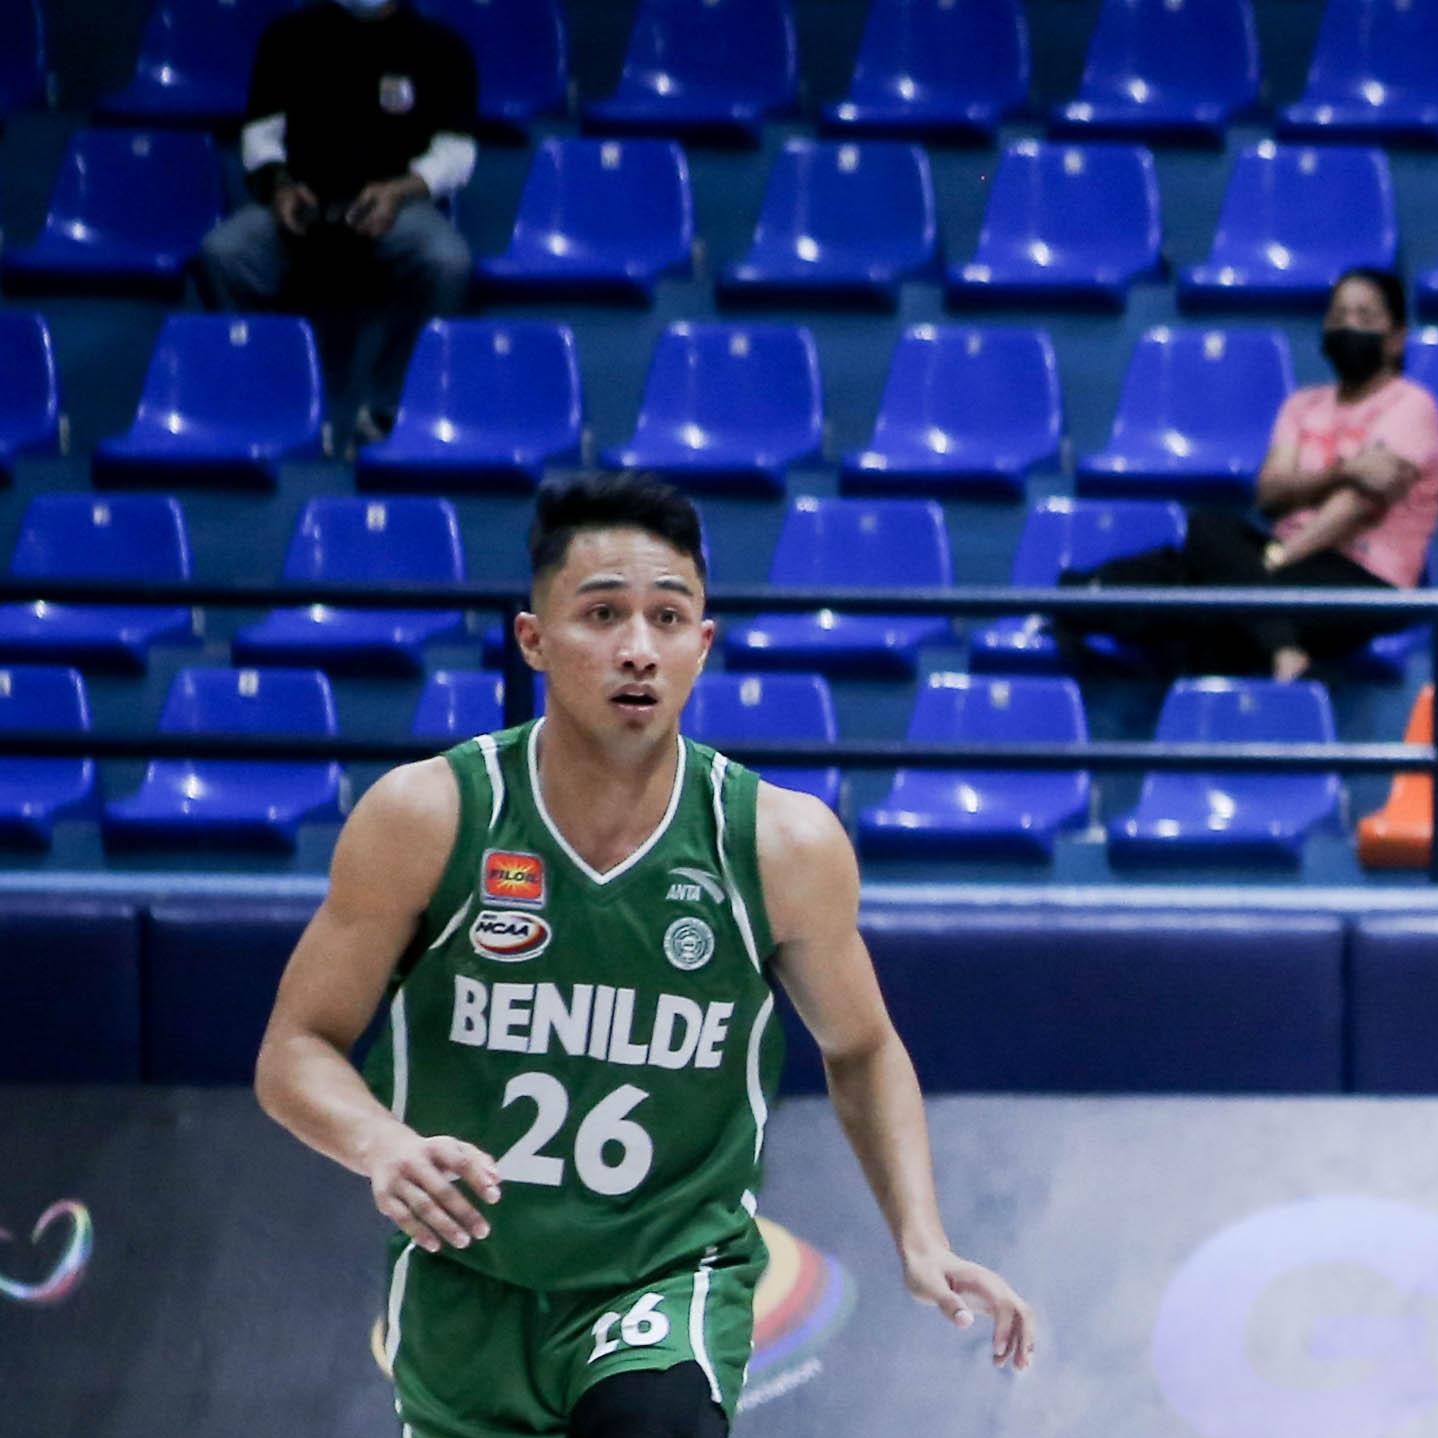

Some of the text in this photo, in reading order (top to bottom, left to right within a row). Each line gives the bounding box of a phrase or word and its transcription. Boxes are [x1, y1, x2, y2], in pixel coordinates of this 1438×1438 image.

[665, 884, 700, 901] ANTA
[476, 921, 529, 937] NCAA
[449, 974, 736, 1071] BENILDE
[497, 1071, 654, 1197] 26
